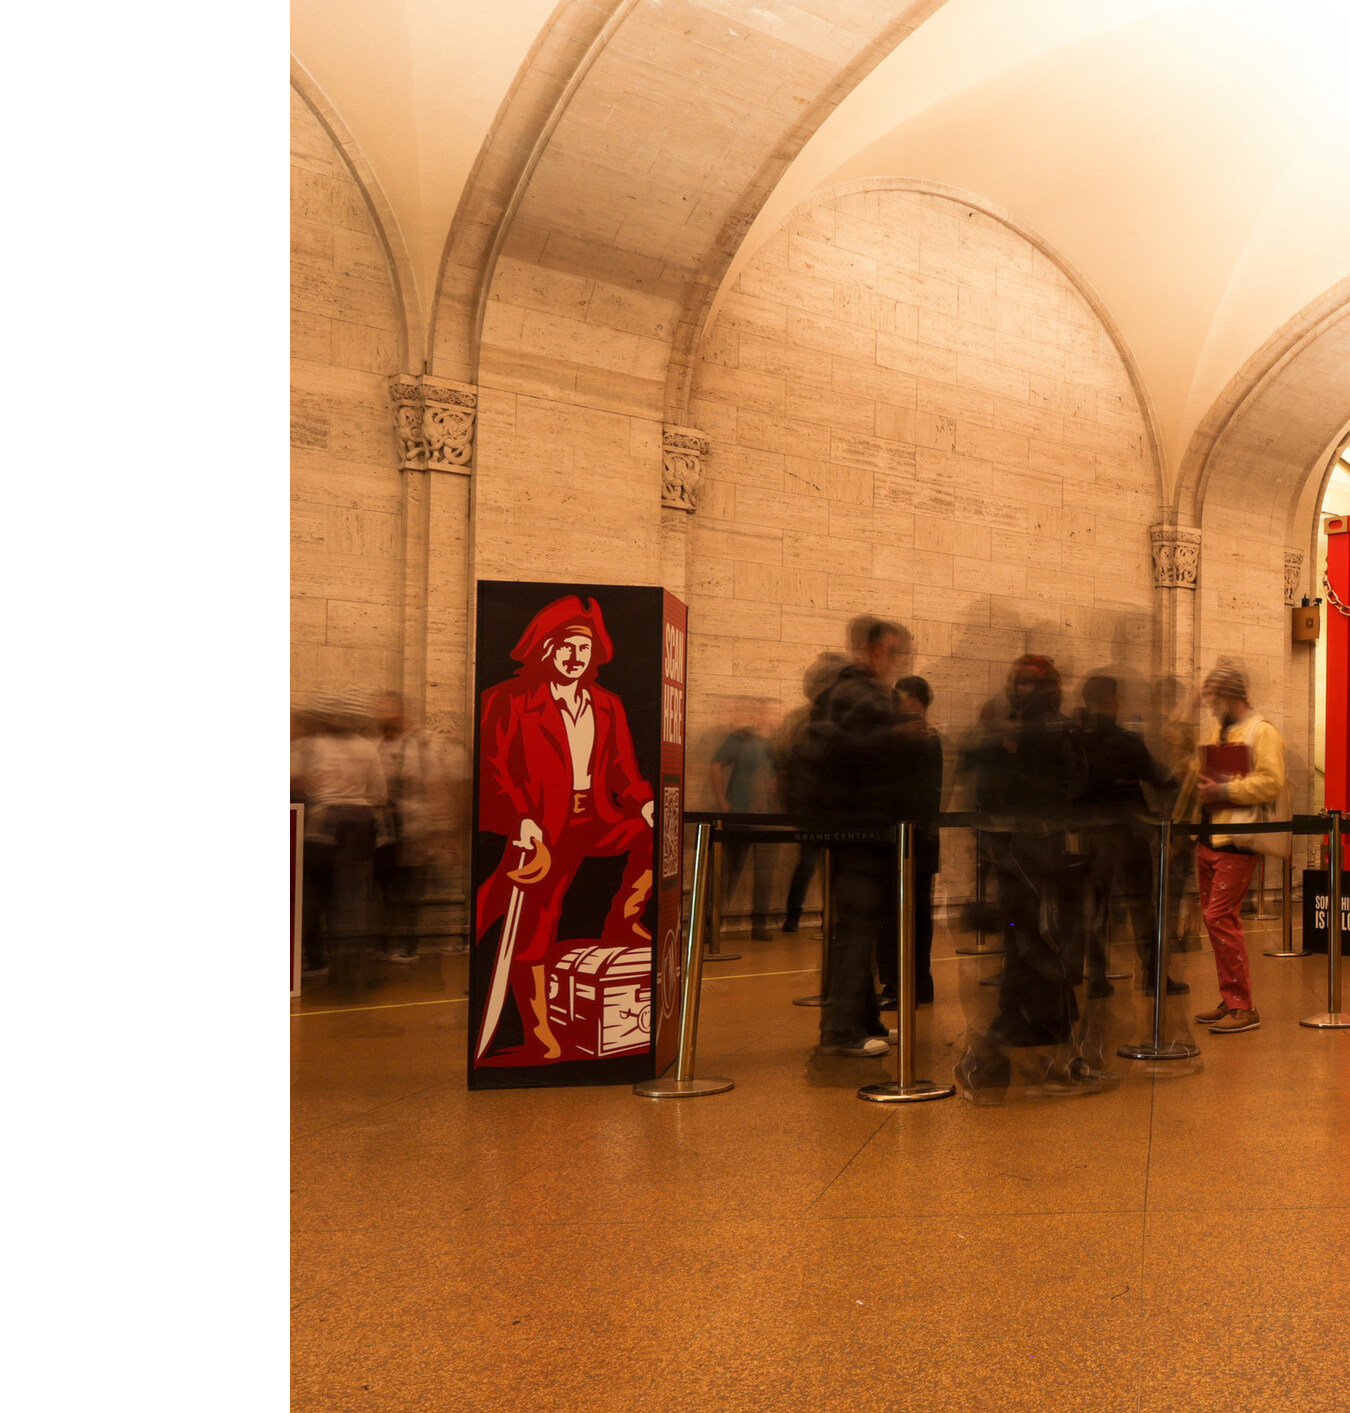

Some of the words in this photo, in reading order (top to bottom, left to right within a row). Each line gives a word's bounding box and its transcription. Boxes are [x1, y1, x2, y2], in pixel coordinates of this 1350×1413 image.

[665, 622, 684, 683] SCAN
[663, 683, 682, 744] HERE
[795, 833, 831, 841] GRAND
[834, 832, 880, 840] CENTRAL
[1315, 911, 1325, 929] IS
